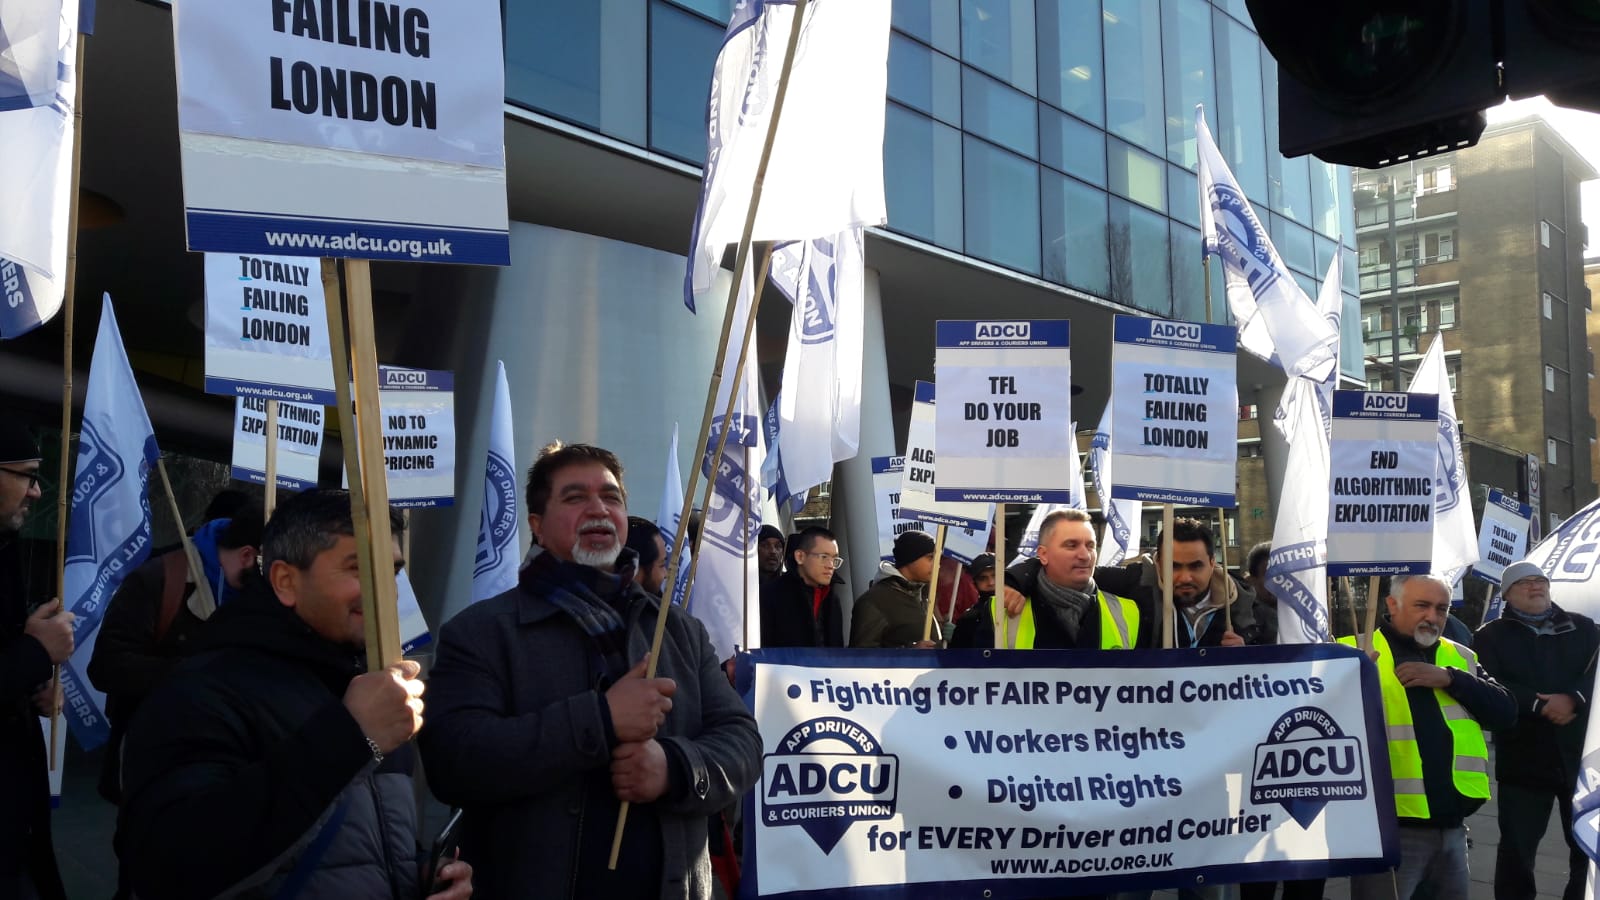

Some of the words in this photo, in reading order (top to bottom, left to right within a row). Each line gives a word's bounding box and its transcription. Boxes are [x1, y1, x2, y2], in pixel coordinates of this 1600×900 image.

[271, 0, 431, 58] FAILING
[270, 56, 437, 130] LONDON
[265, 231, 453, 258] www.adcu.org.uk
[239, 256, 309, 287] TOTALLY
[243, 286, 309, 317] FAILING
[242, 317, 310, 346] LONDON
[978, 325, 1028, 338] ADCU
[1153, 323, 1199, 340] ADCU
[388, 373, 424, 384] ADCU
[989, 376, 1017, 394] TFL
[1144, 373, 1209, 395] TOTALLY
[236, 386, 313, 401] www.adcu.org.uk
[1365, 395, 1406, 409] ADCU
[242, 397, 320, 426] ALGITHMIC
[965, 402, 988, 420] DO
[993, 402, 1041, 420] YOUR
[1145, 400, 1207, 422] FAILING
[242, 416, 319, 447] EXPLITATION
[388, 416, 406, 430] NO
[409, 416, 426, 430] TO
[986, 429, 1019, 447] JOB
[1143, 427, 1208, 449] LONDON
[1370, 450, 1398, 469] END
[963, 493, 1043, 502] www.adcu.org.uk
[1137, 491, 1210, 504] www.adcu.org.uk
[1334, 477, 1431, 496] ALGORITHMIC
[500, 479, 515, 538] DRIVERS
[1335, 504, 1430, 522] EXPLOITATION
[1502, 496, 1519, 510] ADCU
[1493, 525, 1517, 543] TOTALLY
[1490, 538, 1514, 555] FAILING
[1348, 565, 1410, 574] www.adcu.org.uk
[1272, 575, 1294, 592] OR
[1293, 590, 1313, 612] ALL
[60, 667, 97, 727] URIERS
[810, 679, 931, 714] Fighting
[938, 680, 979, 706] for
[986, 682, 1049, 705] FAIR
[1055, 680, 1111, 712] Pay
[1117, 680, 1173, 704] and
[1179, 674, 1324, 702] Conditions
[1273, 716, 1292, 741] APP
[1294, 710, 1336, 736] DRIVERS
[787, 725, 811, 752] APP
[815, 721, 874, 753] DRIVERS
[965, 729, 1089, 754] Workers
[1095, 725, 1186, 759] Rights
[1257, 745, 1354, 780] ADCU
[767, 763, 891, 798] ADCU
[987, 775, 1084, 812] Digital
[1088, 773, 1182, 808] Rights
[1255, 790, 1262, 800] &
[1264, 787, 1319, 799] COURIERS
[1322, 785, 1362, 797] UNION
[768, 810, 778, 821] &
[781, 806, 845, 820] COURIERS
[849, 805, 891, 816] UNION
[867, 825, 911, 852] for
[918, 826, 1015, 850] EVERY
[1021, 824, 1114, 849] Driver
[1119, 819, 1172, 846] and
[1178, 809, 1271, 841] Courier
[991, 853, 1174, 874] WWW.ADCU.ORG.UK
